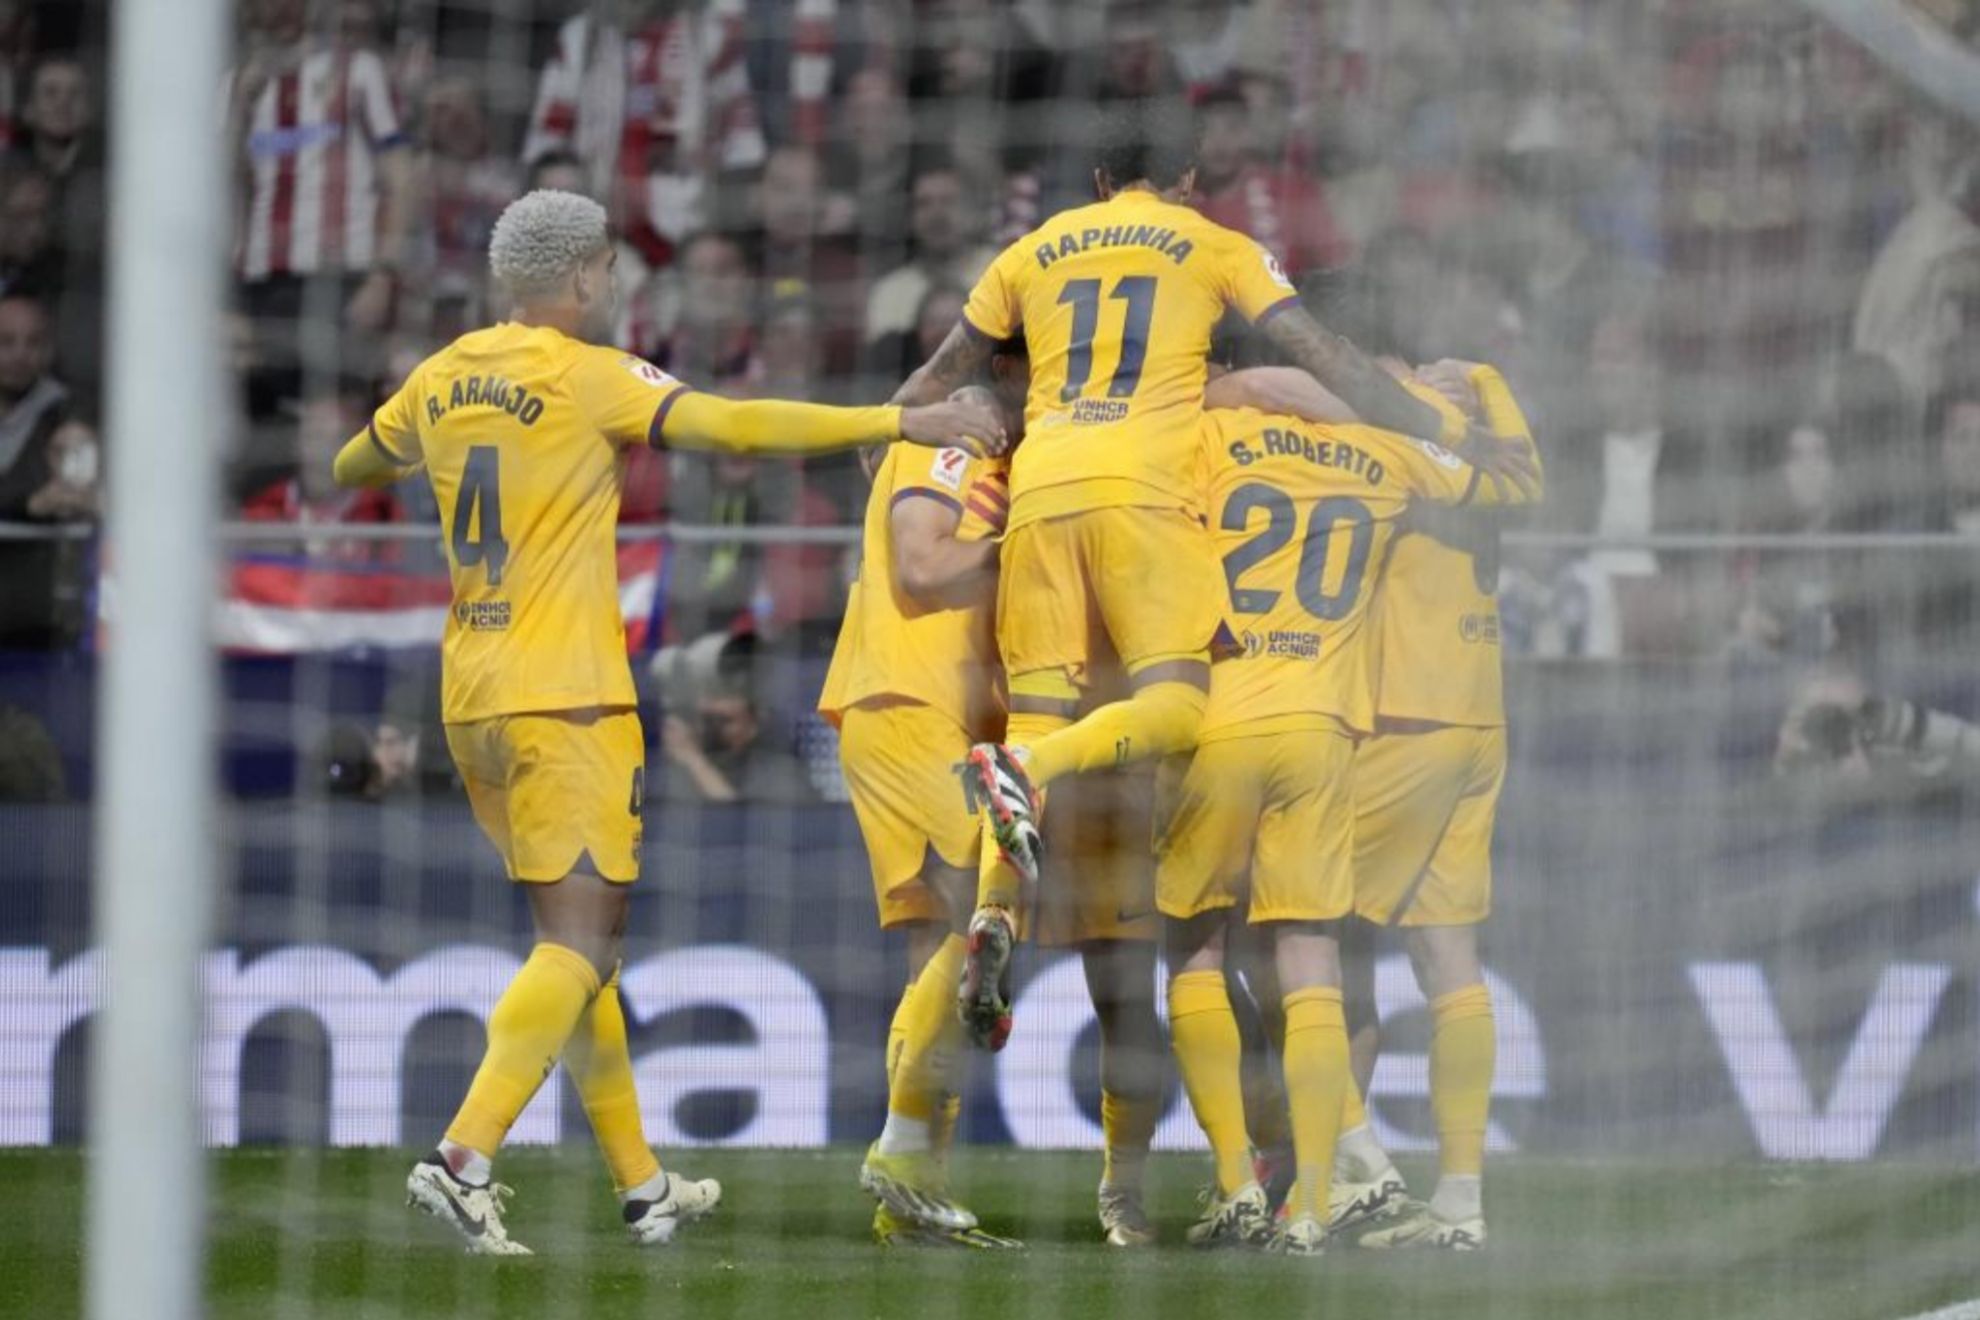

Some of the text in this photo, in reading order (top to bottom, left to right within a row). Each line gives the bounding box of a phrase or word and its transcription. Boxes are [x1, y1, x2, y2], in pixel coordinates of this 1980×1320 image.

[1036, 225, 1193, 269] RAPHINHA
[1056, 275, 1158, 403] 11
[452, 445, 509, 586] 4
[1221, 482, 1375, 621] 20
